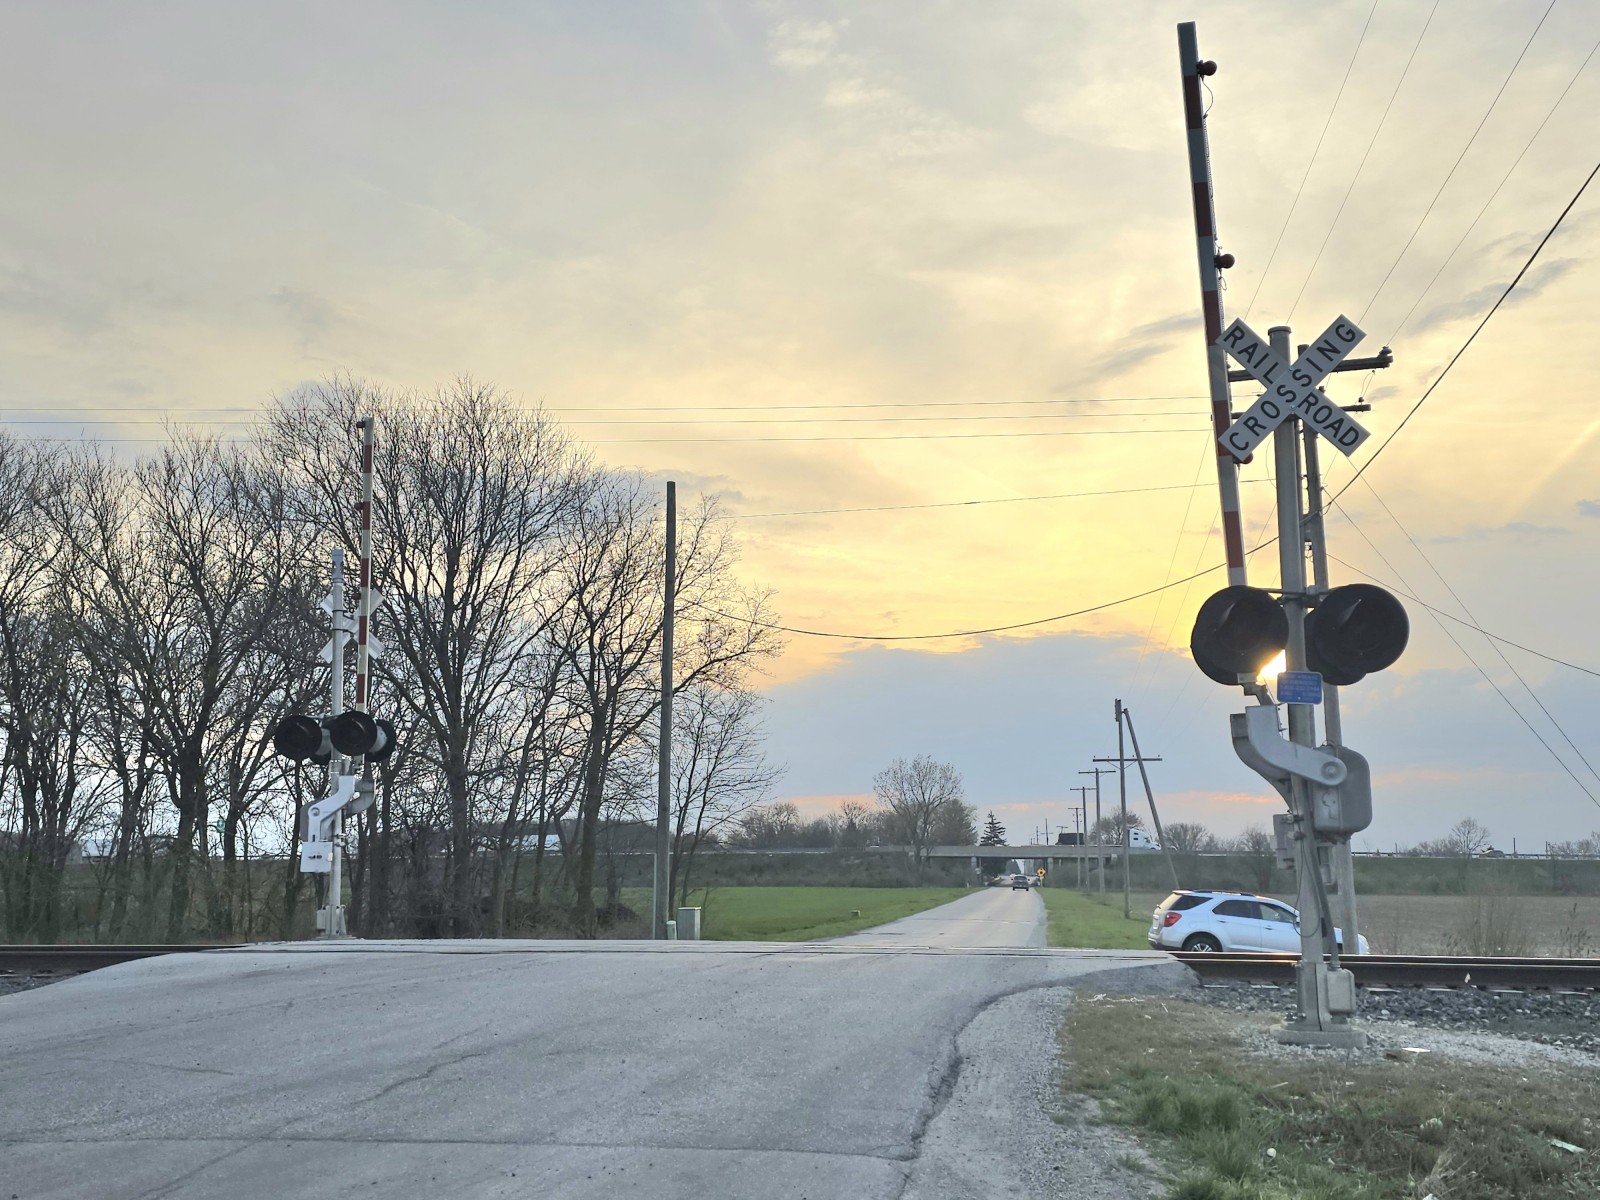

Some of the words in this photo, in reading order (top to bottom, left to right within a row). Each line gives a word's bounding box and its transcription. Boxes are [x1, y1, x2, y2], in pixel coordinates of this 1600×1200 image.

[1223, 325, 1279, 384] RAIL
[1298, 392, 1360, 447] ROAD
[1229, 324, 1357, 451] CROSSING
